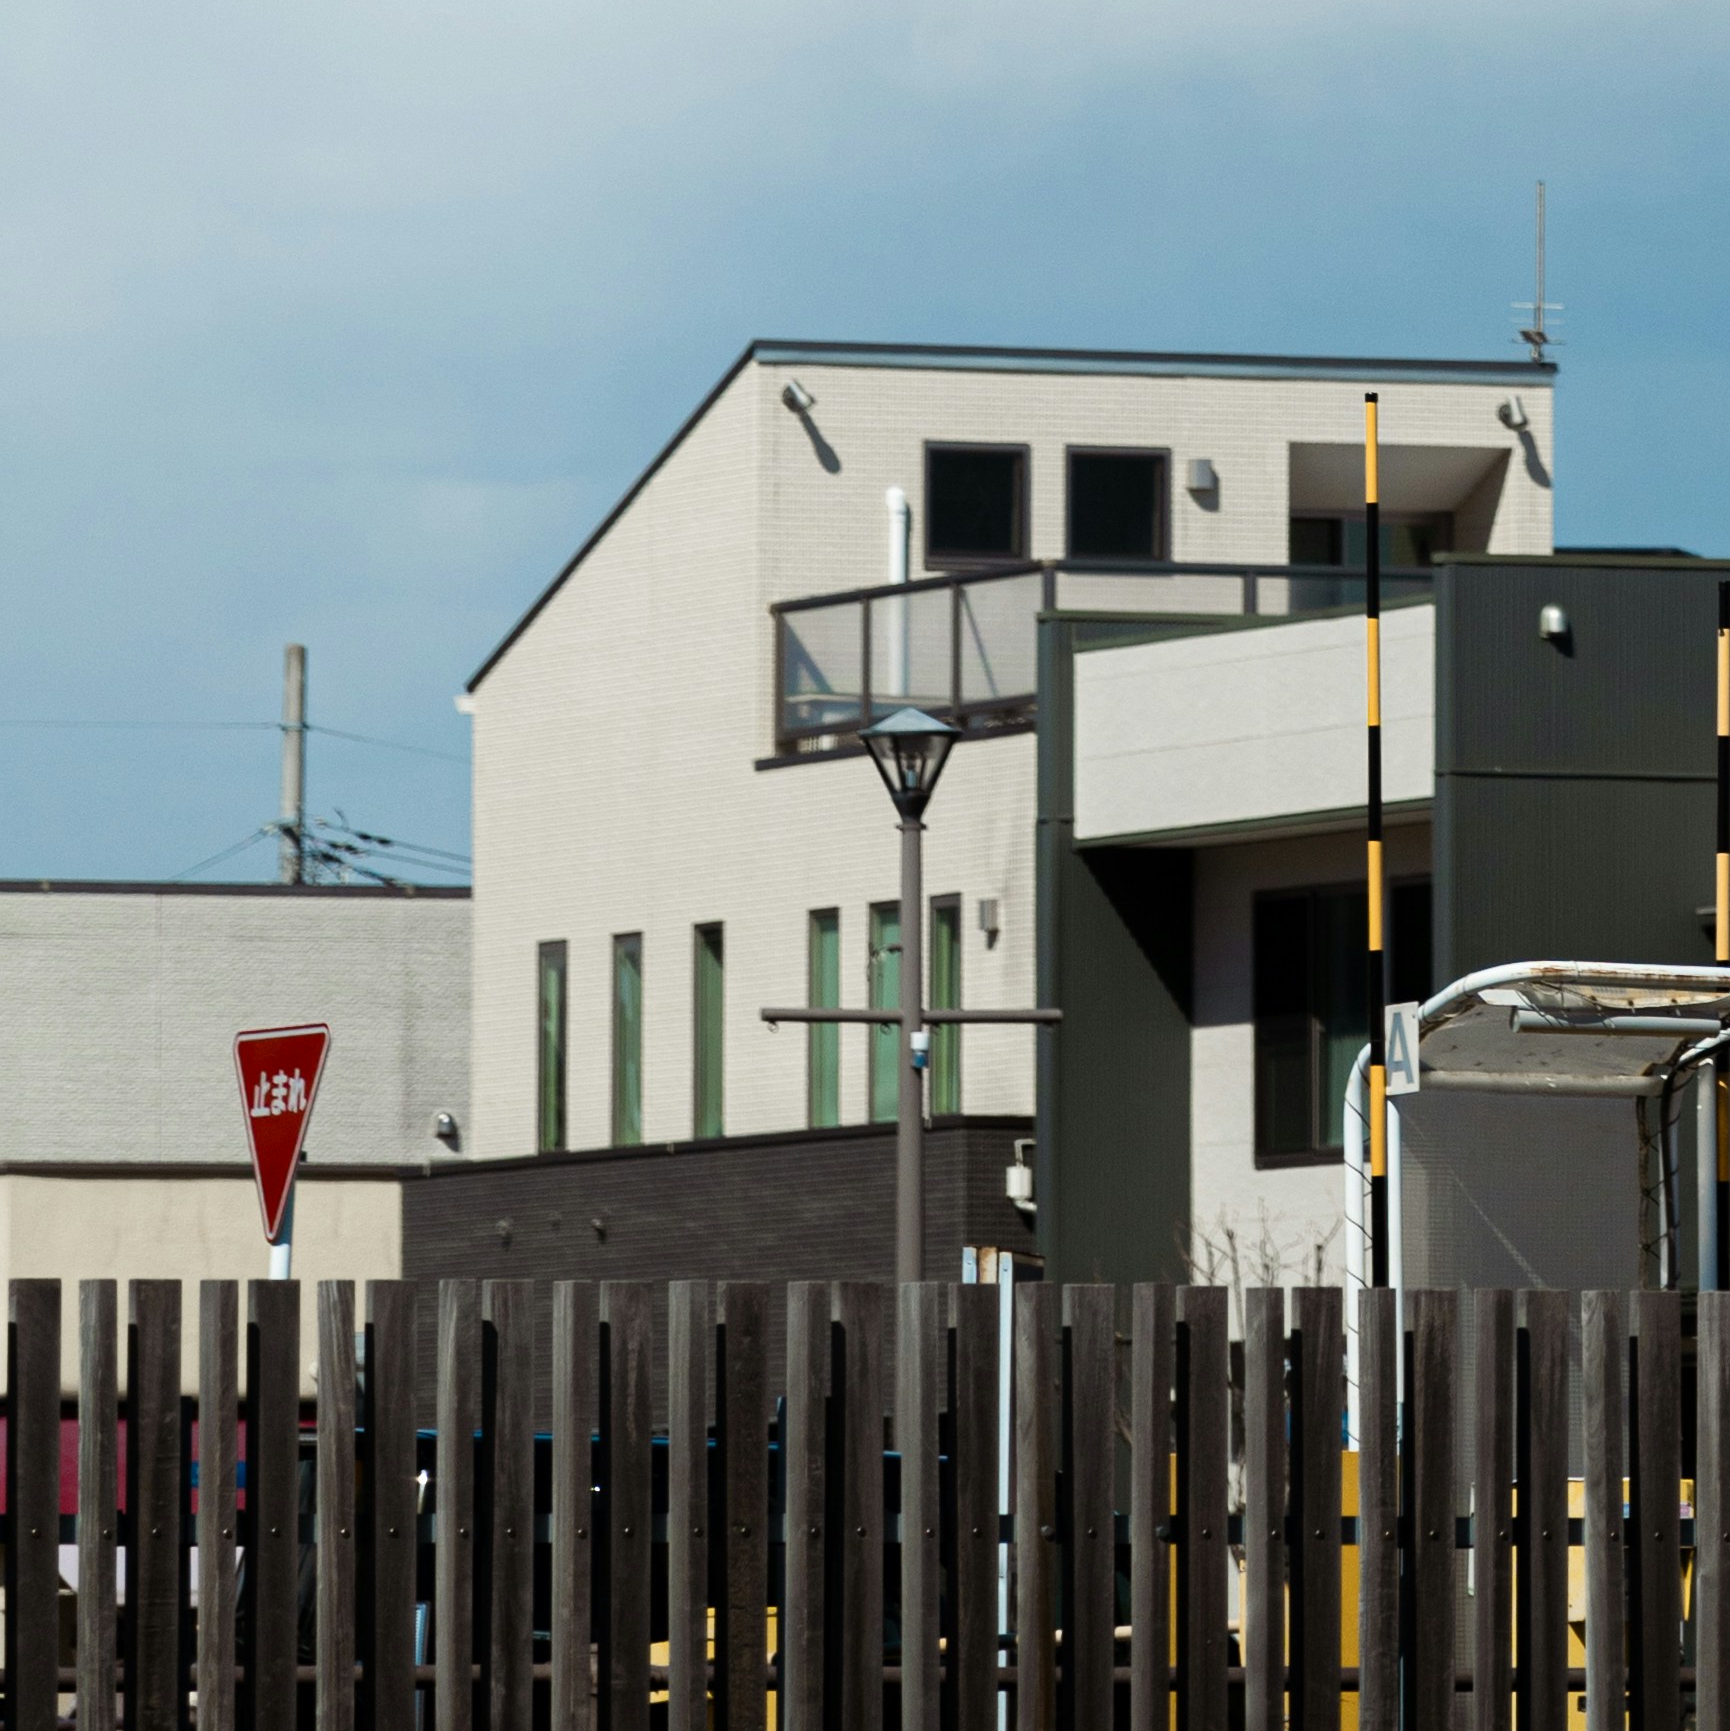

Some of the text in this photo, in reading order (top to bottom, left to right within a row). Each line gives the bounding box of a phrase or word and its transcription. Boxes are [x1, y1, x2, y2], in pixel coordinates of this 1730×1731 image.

[1387, 1011, 1414, 1087] A
[249, 1067, 308, 1118] 止まれ
